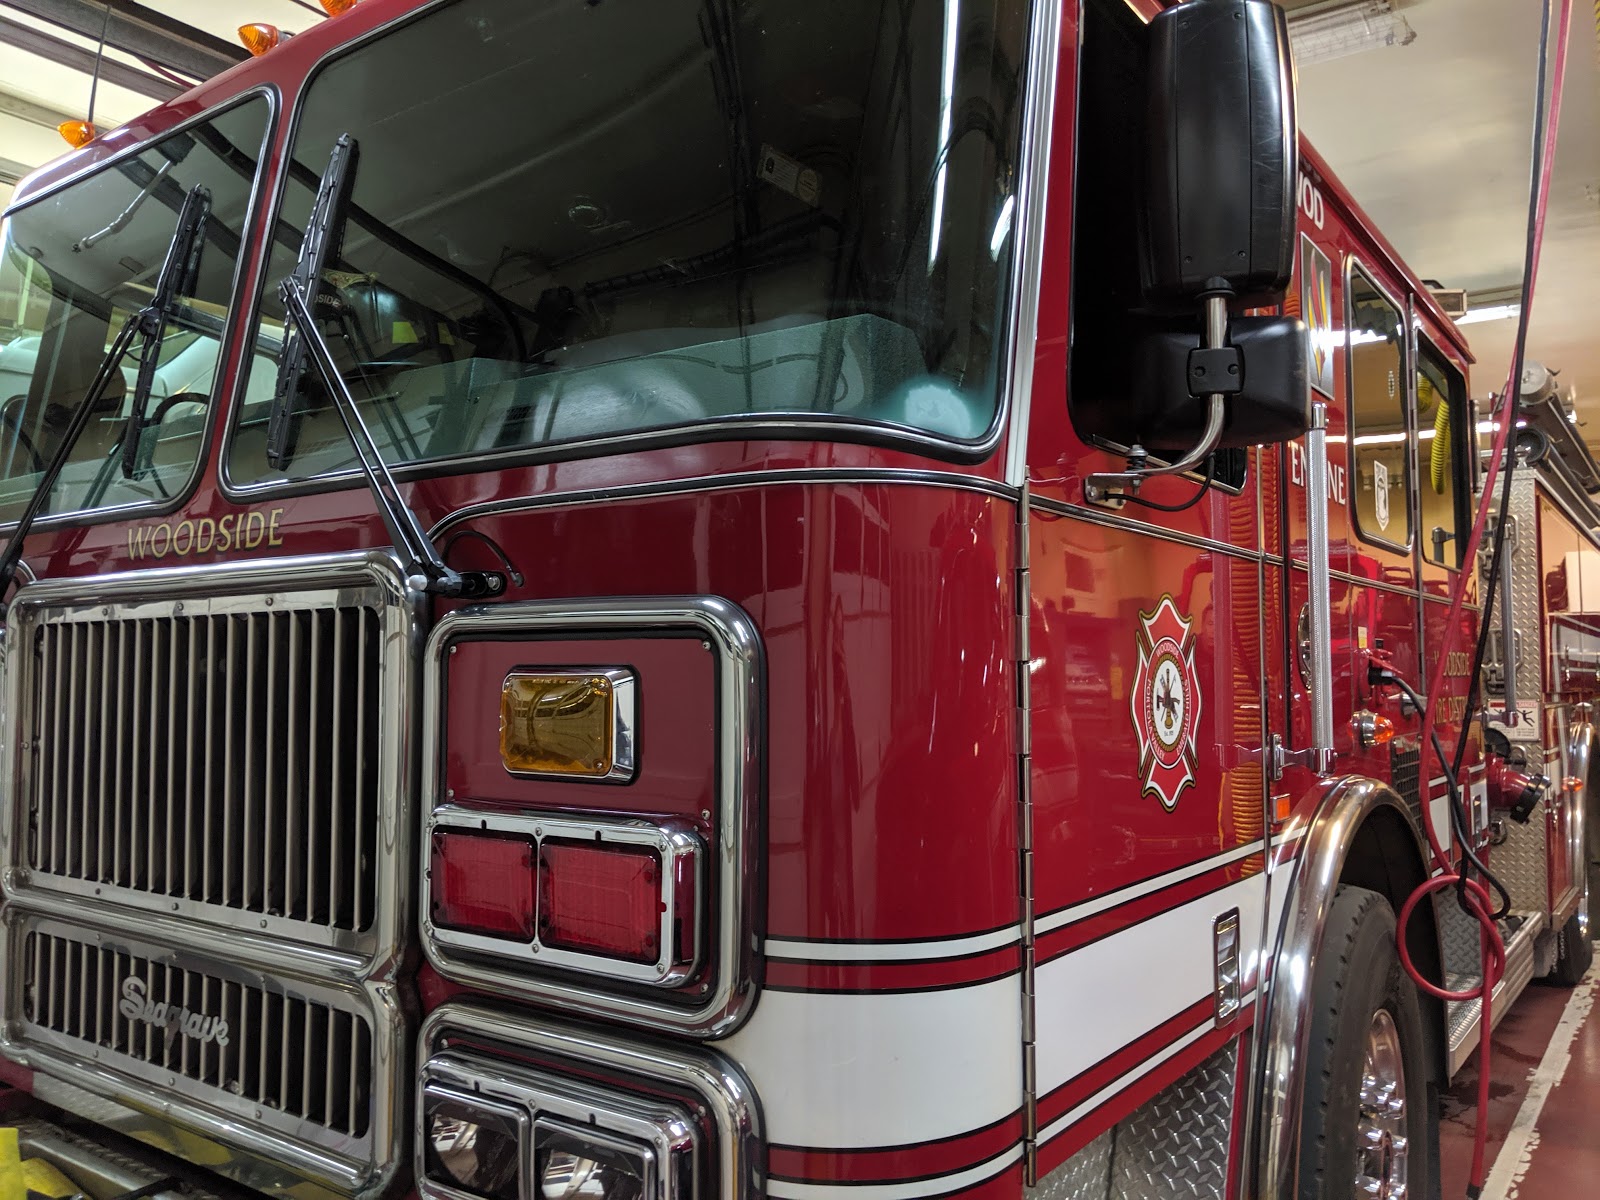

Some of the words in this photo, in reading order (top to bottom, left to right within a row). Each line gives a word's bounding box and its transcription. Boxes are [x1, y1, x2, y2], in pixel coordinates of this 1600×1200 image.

[1291, 440, 1346, 506] ENNE
[127, 508, 284, 561] WOODSIDE
[1156, 642, 1180, 659] WOODSIDE
